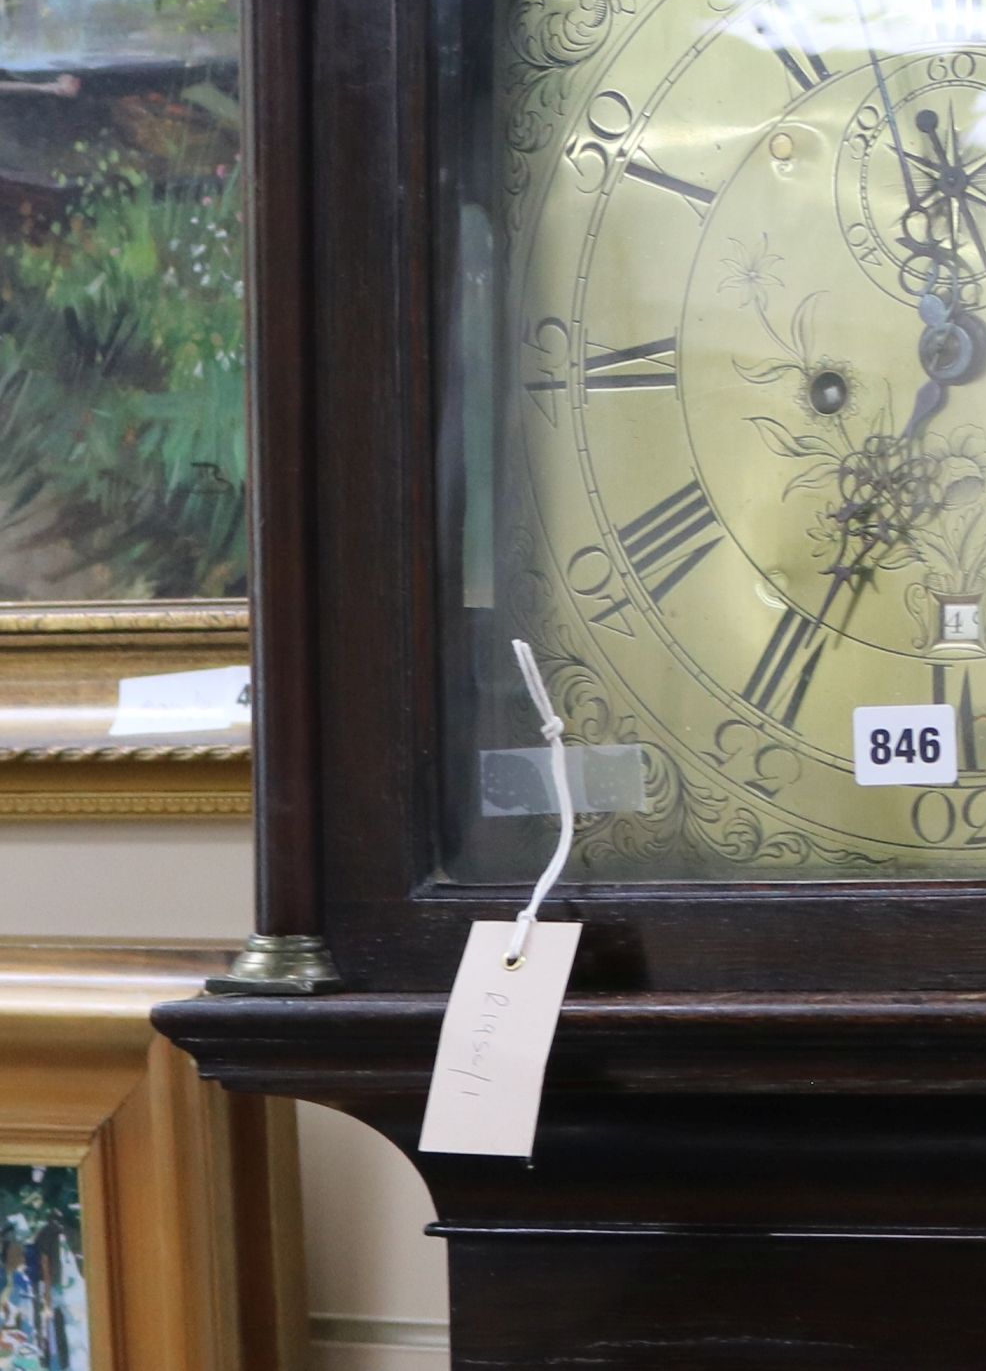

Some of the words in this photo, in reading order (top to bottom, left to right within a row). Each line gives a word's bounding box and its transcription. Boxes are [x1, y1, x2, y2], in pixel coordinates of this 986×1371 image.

[927, 52, 975, 81] 60
[564, 90, 632, 194] 50
[522, 316, 574, 429] 45
[614, 467, 727, 617] VIII
[566, 546, 636, 639] 40
[702, 718, 801, 799] 35
[870, 727, 940, 764] 846
